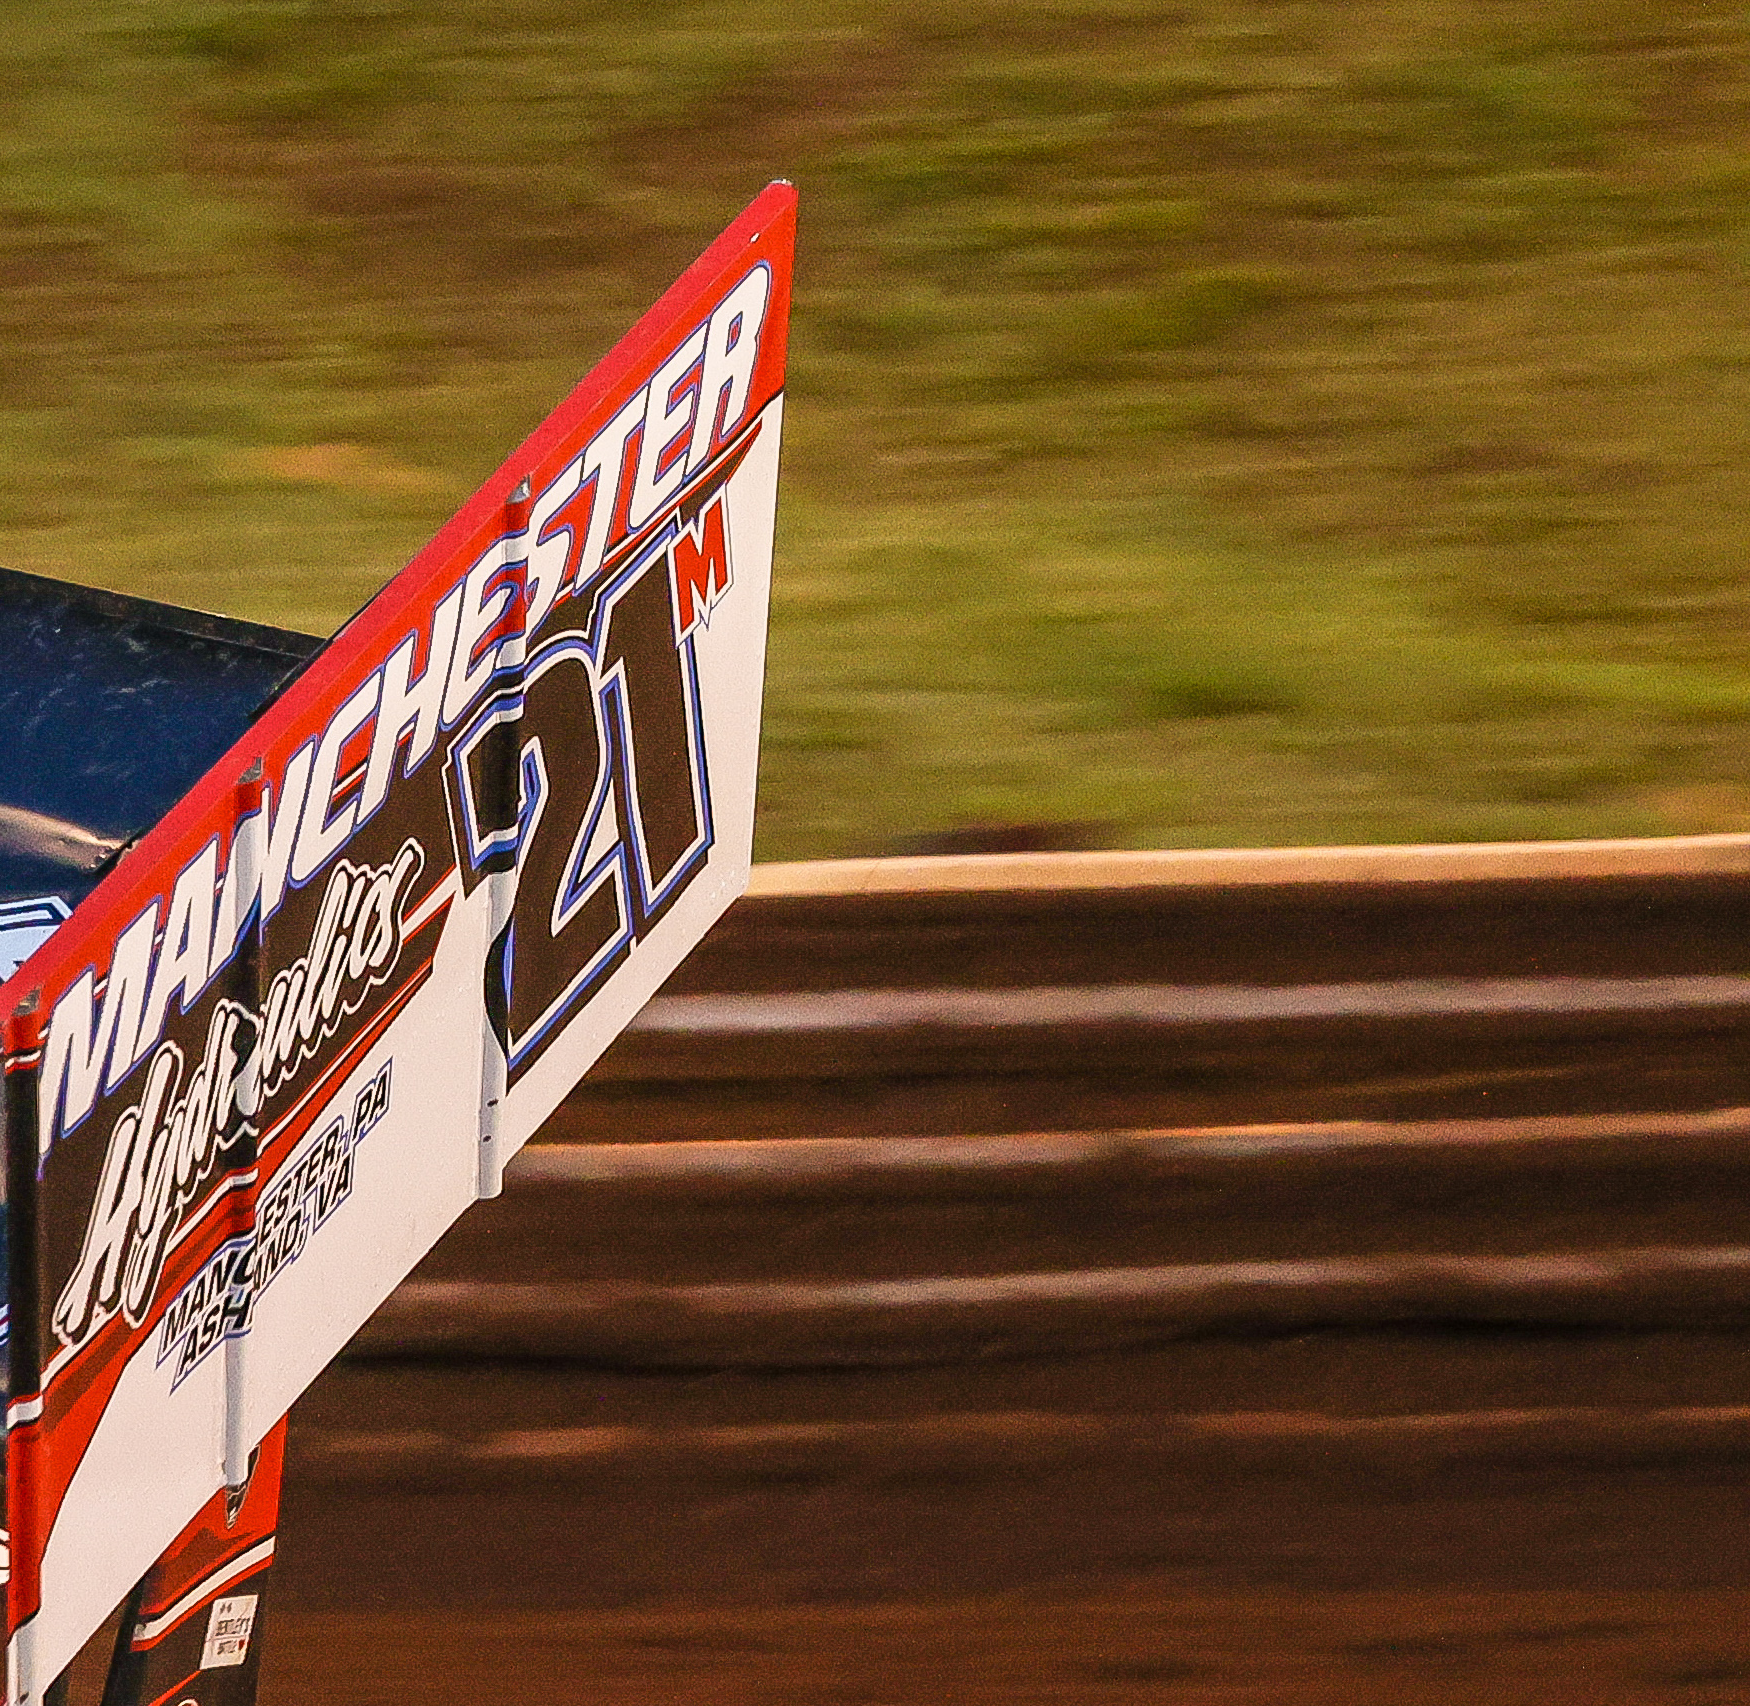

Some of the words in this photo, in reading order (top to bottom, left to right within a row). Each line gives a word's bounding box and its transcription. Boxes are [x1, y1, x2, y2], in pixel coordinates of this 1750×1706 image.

[39, 258, 773, 1160] MANCHESTER
[56, 842, 419, 1338] Hydraulics
[316, 1149, 353, 1223] VA
[352, 1066, 390, 1143] PA
